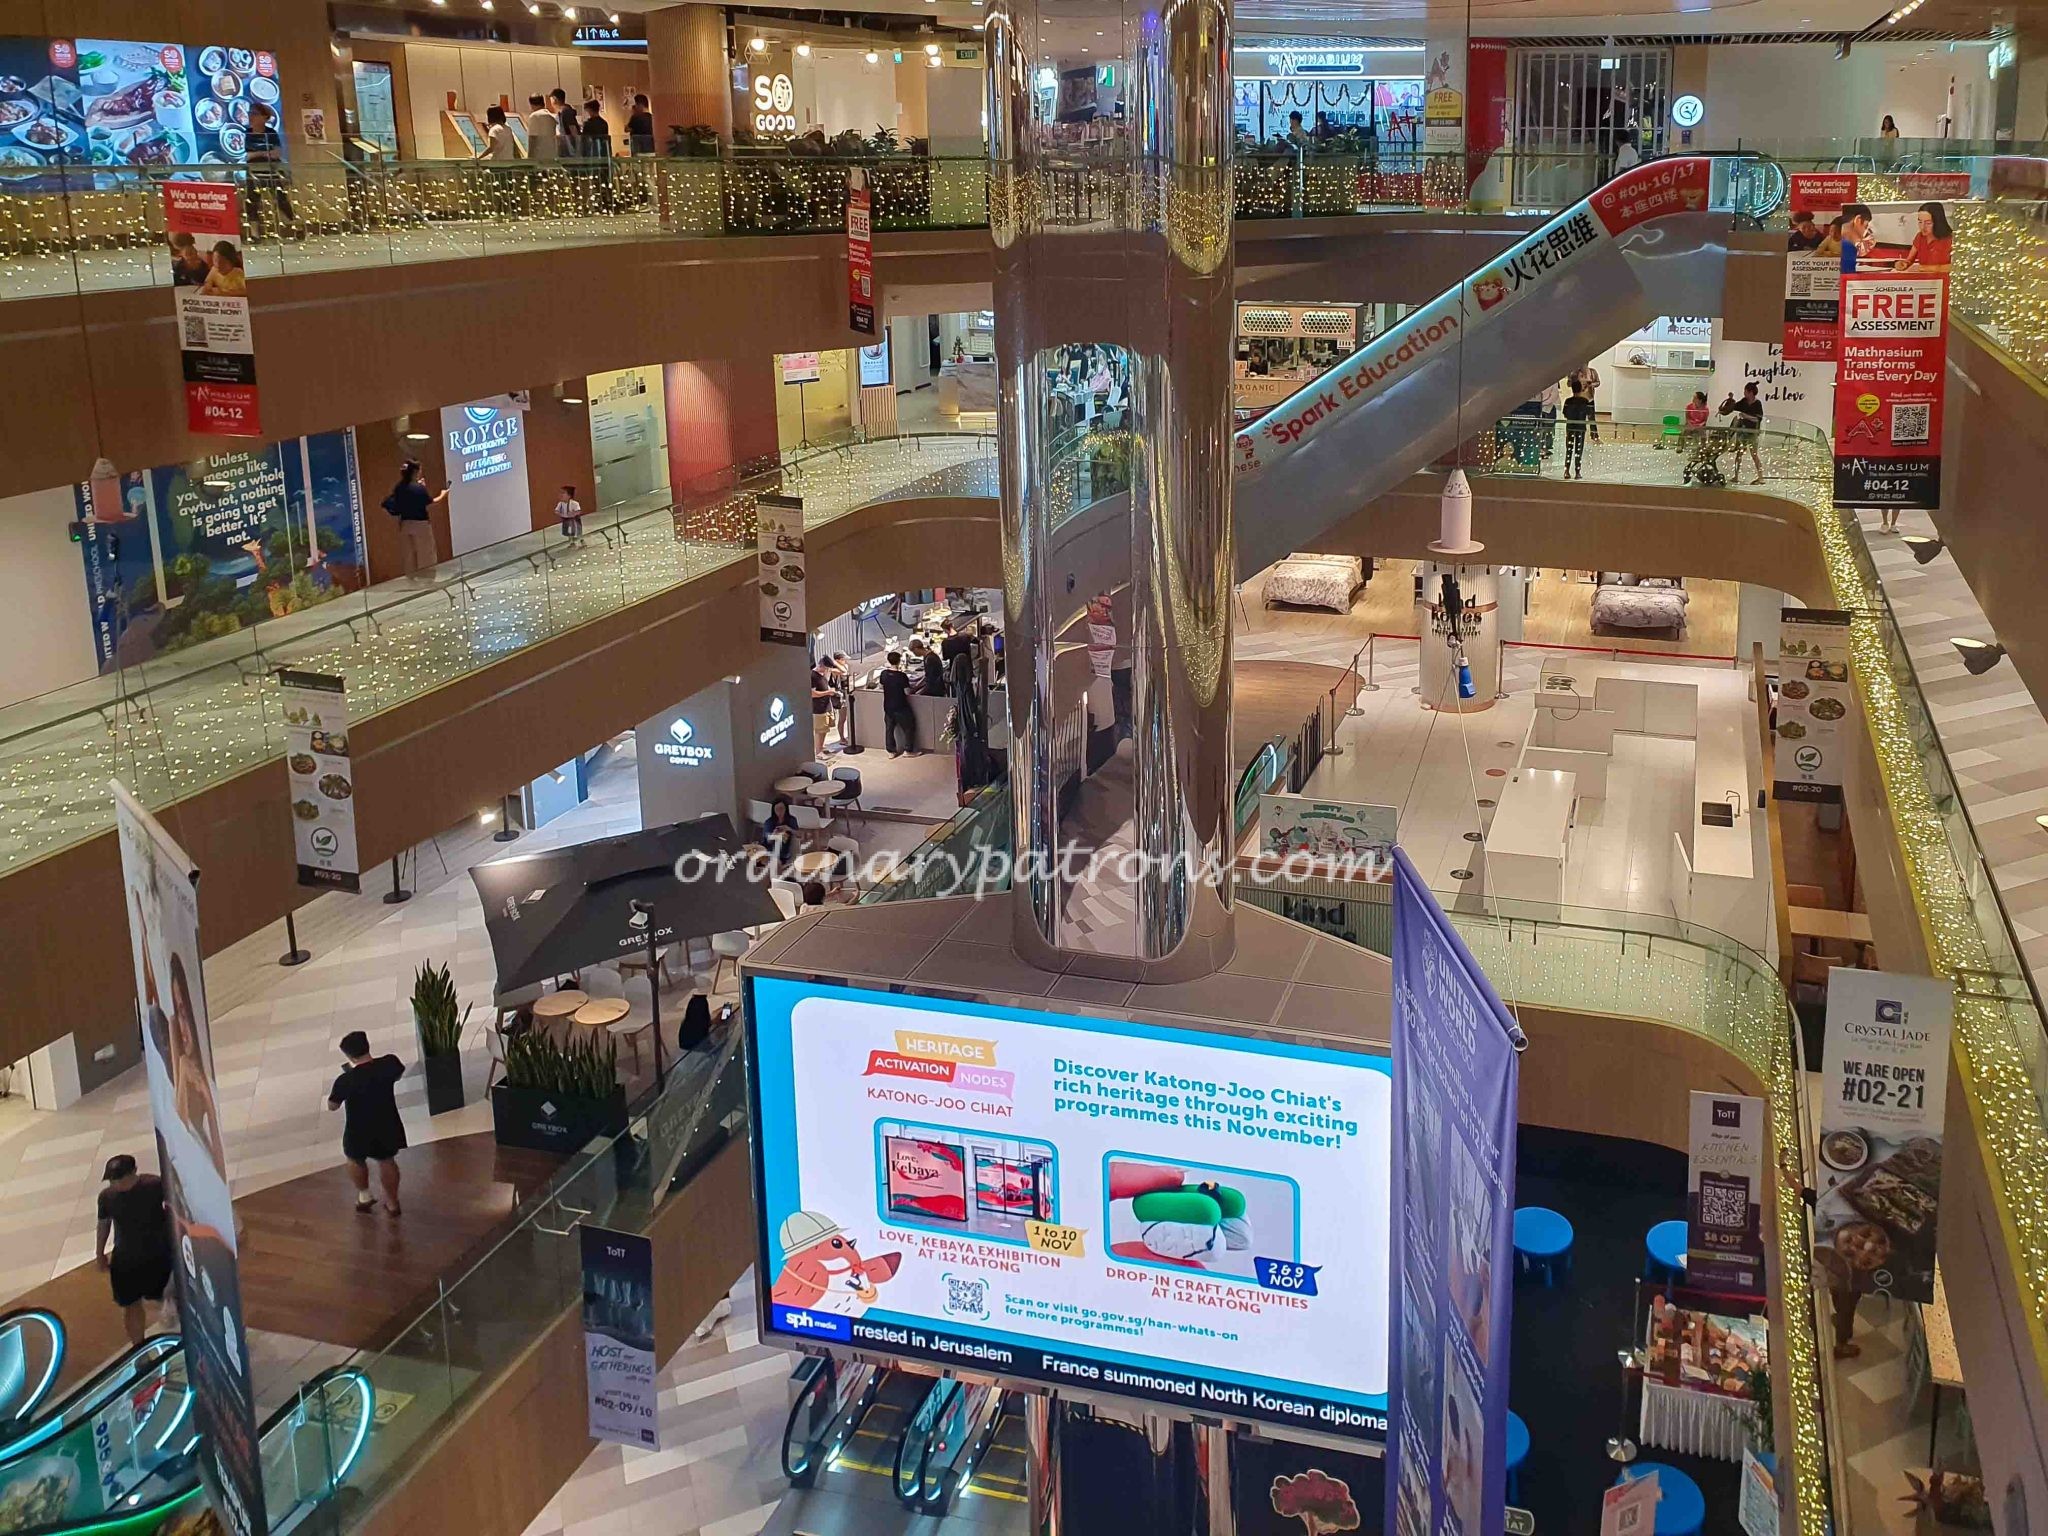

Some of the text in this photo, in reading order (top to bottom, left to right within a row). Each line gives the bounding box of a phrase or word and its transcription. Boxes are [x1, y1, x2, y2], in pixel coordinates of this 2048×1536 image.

[960, 51, 974, 59] EXIT
[1434, 92, 1453, 102] FREE
[755, 114, 796, 132] GOOD
[1602, 162, 1695, 208] @ #04-16/17
[1823, 180, 1851, 188] serious
[170, 190, 228, 201] We're serious
[174, 200, 226, 211] about maths
[851, 214, 868, 232] FREE
[1504, 212, 1598, 291] 火花思维
[1852, 294, 1936, 319] FREE
[1851, 321, 1935, 331] ASSESSMENT
[1798, 340, 1832, 349] #04-12
[1845, 346, 1923, 358] Mathnasium
[1744, 361, 1802, 384] laughter,
[1844, 358, 1916, 369] Transforms
[1271, 315, 1459, 445] Spark Education
[1844, 370, 1938, 384] Lives Every Day
[1782, 387, 1804, 401] love
[205, 406, 243, 419] #04-12
[449, 416, 518, 450] ROYCE
[210, 452, 249, 468] Unless
[247, 460, 268, 474] like
[1842, 457, 1929, 476] MATHNASIUM
[239, 479, 247, 488] a
[249, 467, 285, 483] whole
[1864, 480, 1909, 490] #04-12
[241, 484, 286, 502] nothing
[350, 479, 359, 512] UNITED
[192, 496, 277, 528] is going to get
[206, 511, 267, 538] better. It's
[353, 512, 363, 545] WORLD
[227, 531, 251, 546] not.
[760, 714, 795, 744] GREYBOX
[654, 743, 713, 759] GREYBOX
[669, 756, 699, 766] COFFEE
[618, 926, 673, 947] GREYOX
[1439, 953, 1477, 1029] UNITED
[1439, 983, 1476, 1053] WORLD
[1845, 1022, 1931, 1042] CRYSTAL JADE
[906, 1038, 985, 1059] HERITAGE
[875, 1057, 950, 1076] ACTIVATION
[1442, 1046, 1469, 1103] families
[1843, 1060, 1925, 1082] WE ARE OPEN
[961, 1073, 1007, 1088] NODES
[1053, 1058, 1342, 1112] Discover Katong-Joo Chiat's
[1429, 1050, 1459, 1111] preschool
[867, 1087, 1013, 1117] KATONG-JOO CHIAT
[1842, 1077, 1925, 1109] #02-21
[1054, 1078, 1358, 1136] rich heritage through exciting
[1054, 1096, 1342, 1149] programmes this November!
[896, 1152, 919, 1164] Love,
[891, 1160, 940, 1179] Kebaya
[1033, 1226, 1077, 1241] 1 to 10
[1720, 1233, 1744, 1245] OFF
[879, 1230, 1061, 1268] LOVE, KEBAYA EXHIBITION
[1041, 1239, 1072, 1251] NOV
[918, 1248, 934, 1260] AT
[961, 1255, 1021, 1273] KATONG
[1268, 1262, 1304, 1277] 2 & 9
[1106, 1267, 1309, 1310] DROP-IN CRAFT ACTIVITIES
[1270, 1274, 1304, 1289] NOV
[1151, 1286, 1168, 1299] AT
[1198, 1296, 1261, 1314] KATONG
[786, 1311, 837, 1331] sph media
[1005, 1293, 1239, 1342] Scan or visit go.gov.sg/han-whats-on
[1005, 1305, 1144, 1337] for more programmes!
[592, 1346, 623, 1358] HOST
[853, 1322, 1013, 1364] rrested in Jerusalem
[590, 1360, 652, 1375] GATHERINGS
[1042, 1354, 1388, 1432] France summoned North Korean diploma
[594, 1397, 653, 1418] #02-09/10
